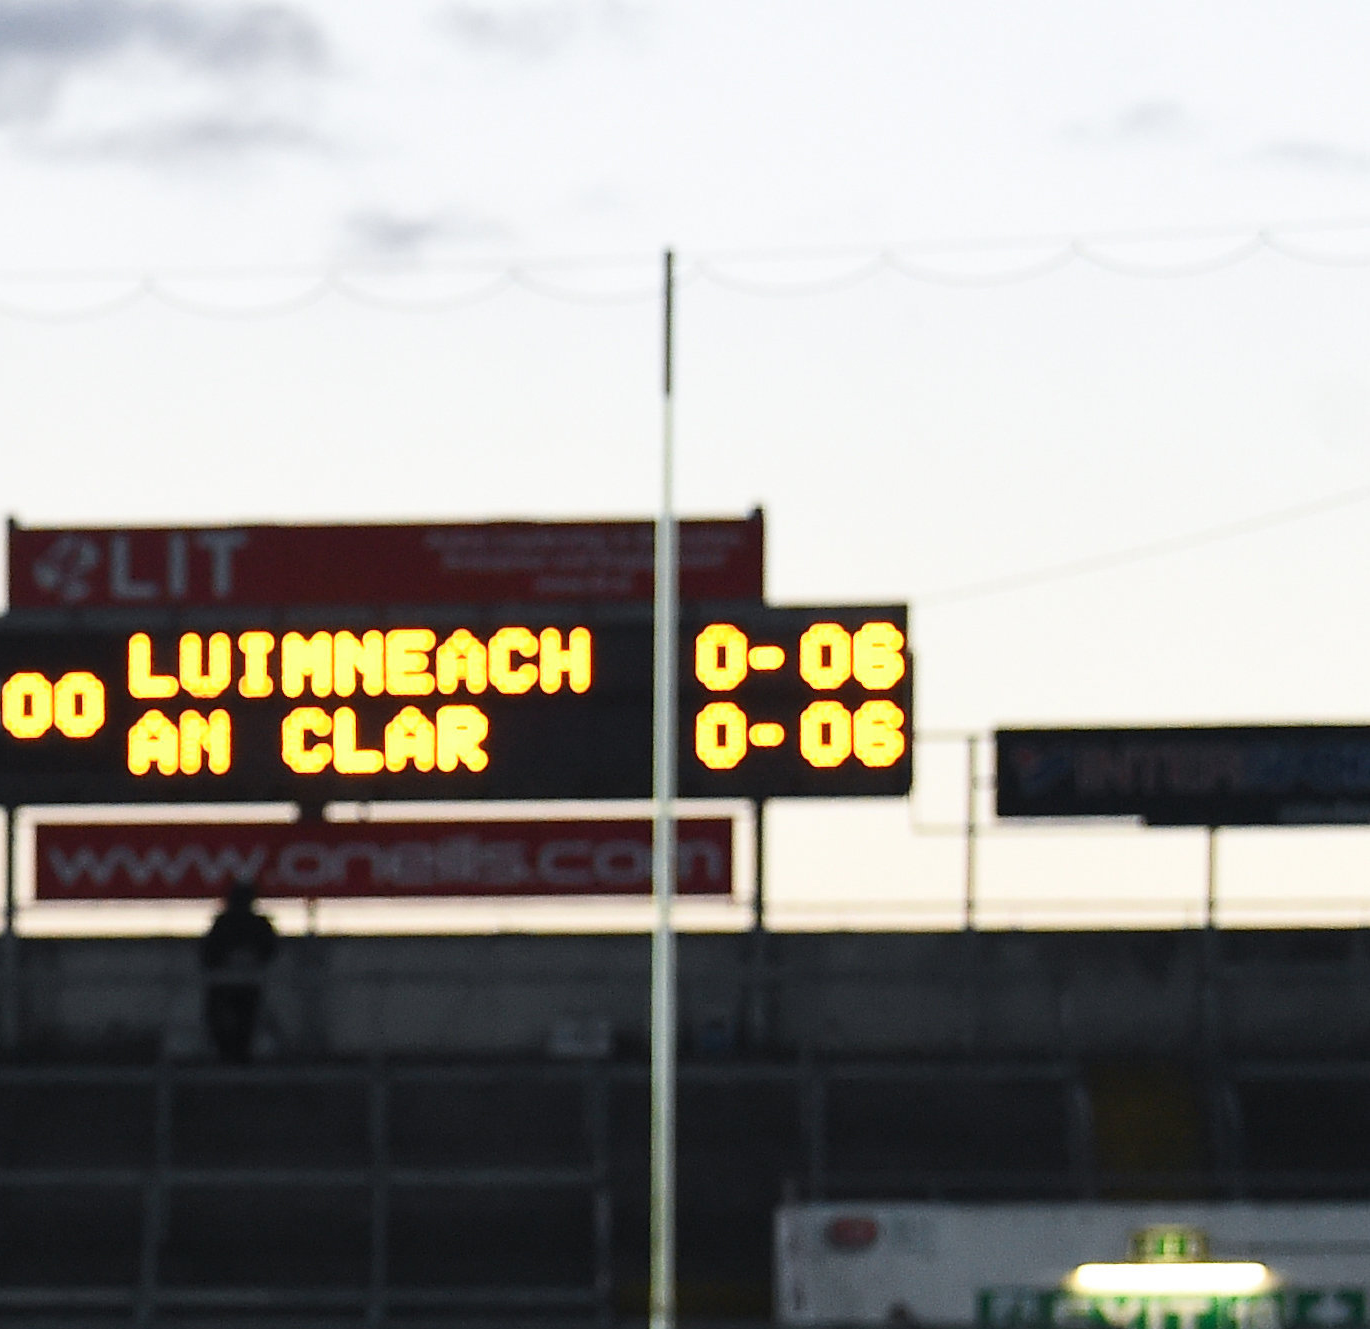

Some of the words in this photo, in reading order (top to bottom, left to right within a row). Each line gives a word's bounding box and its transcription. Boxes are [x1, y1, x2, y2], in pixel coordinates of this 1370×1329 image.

[108, 530, 249, 600] LIT
[127, 625, 592, 700] LUIMNEACH
[127, 708, 232, 776] AN
[280, 703, 489, 775] CLAR
